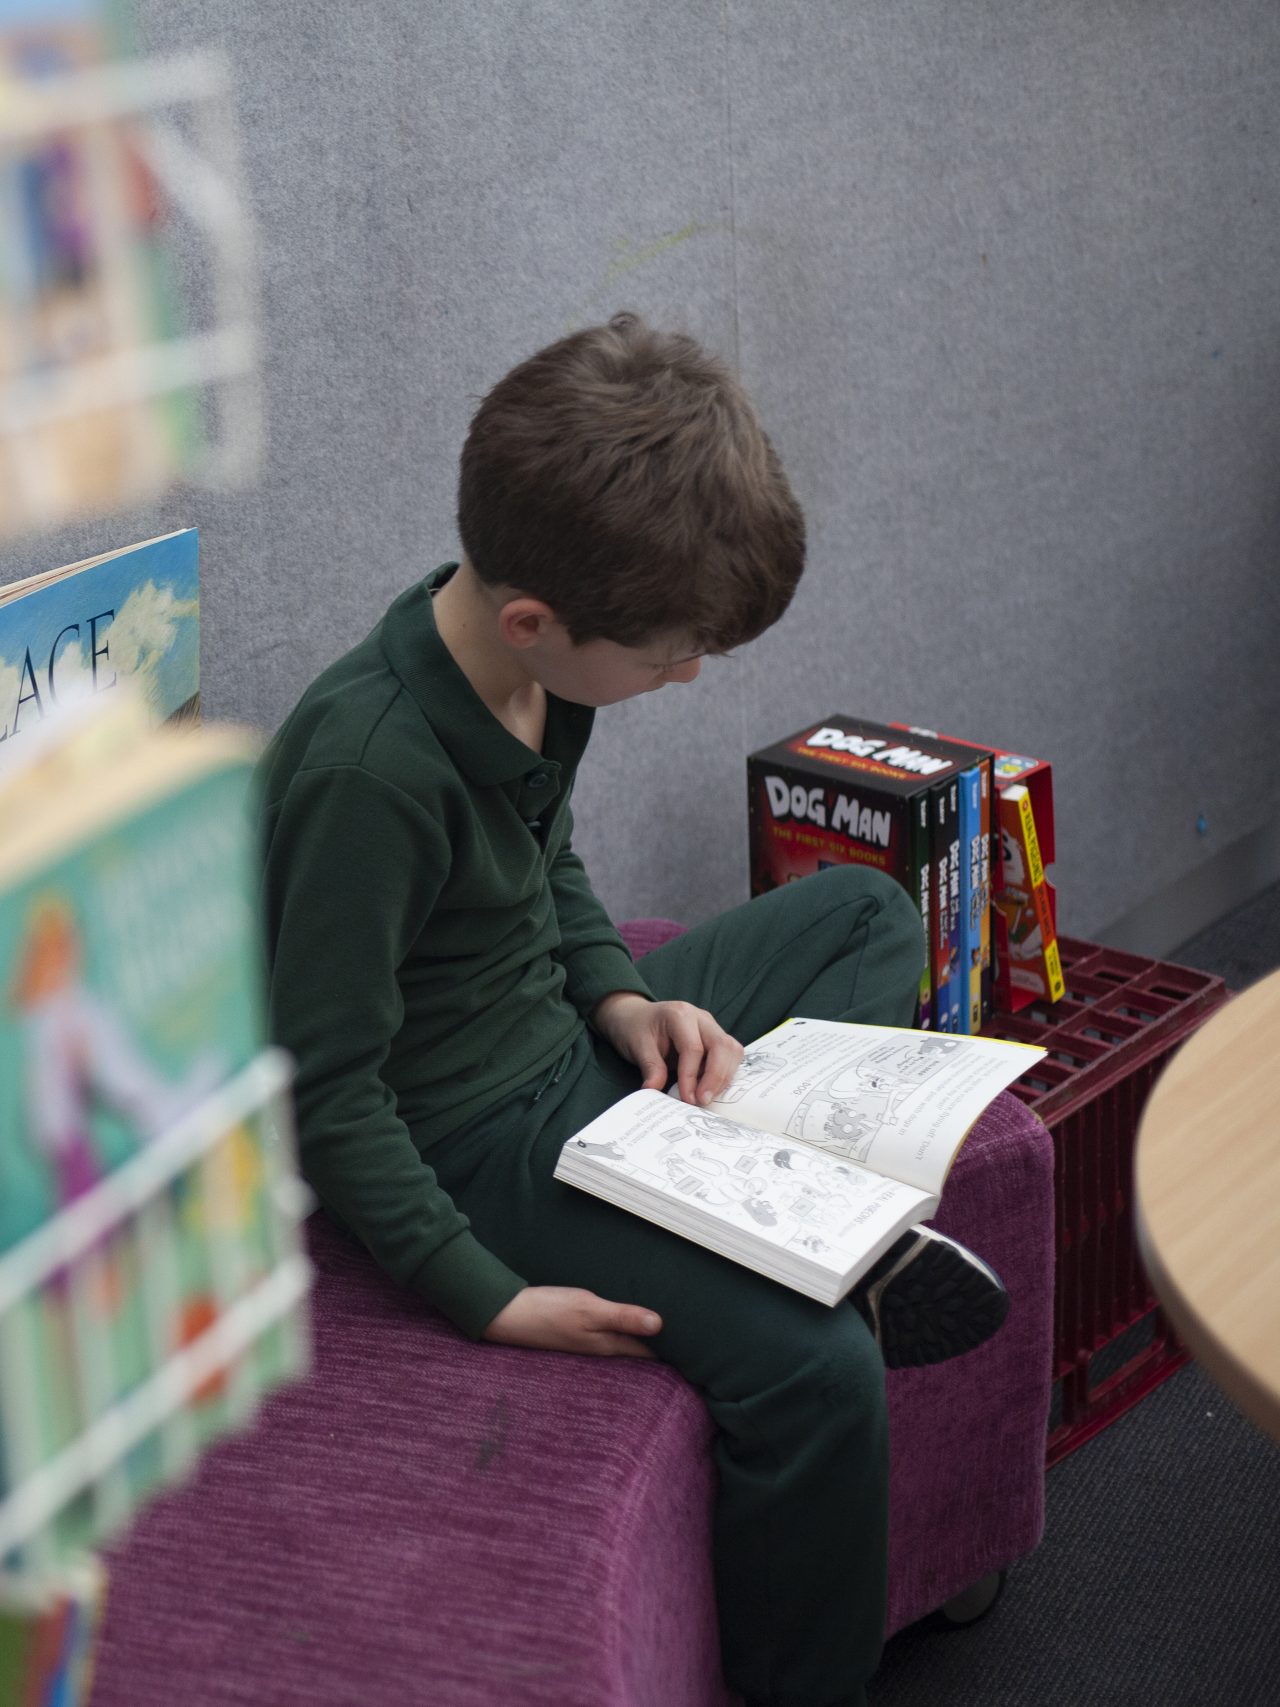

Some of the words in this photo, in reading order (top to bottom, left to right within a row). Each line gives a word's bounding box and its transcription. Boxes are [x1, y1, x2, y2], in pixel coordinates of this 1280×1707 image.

[806, 727, 888, 758] DOG
[871, 746, 954, 776] MAN
[765, 775, 826, 827] DOG
[831, 794, 892, 847] MAN
[773, 827, 792, 841] THE
[796, 831, 825, 848] FIRST
[829, 841, 846, 854] SIX
[850, 845, 886, 865] BOOKS
[949, 839, 960, 871] DOG
[920, 862, 930, 892] DOG
[939, 855, 948, 886] DOG
